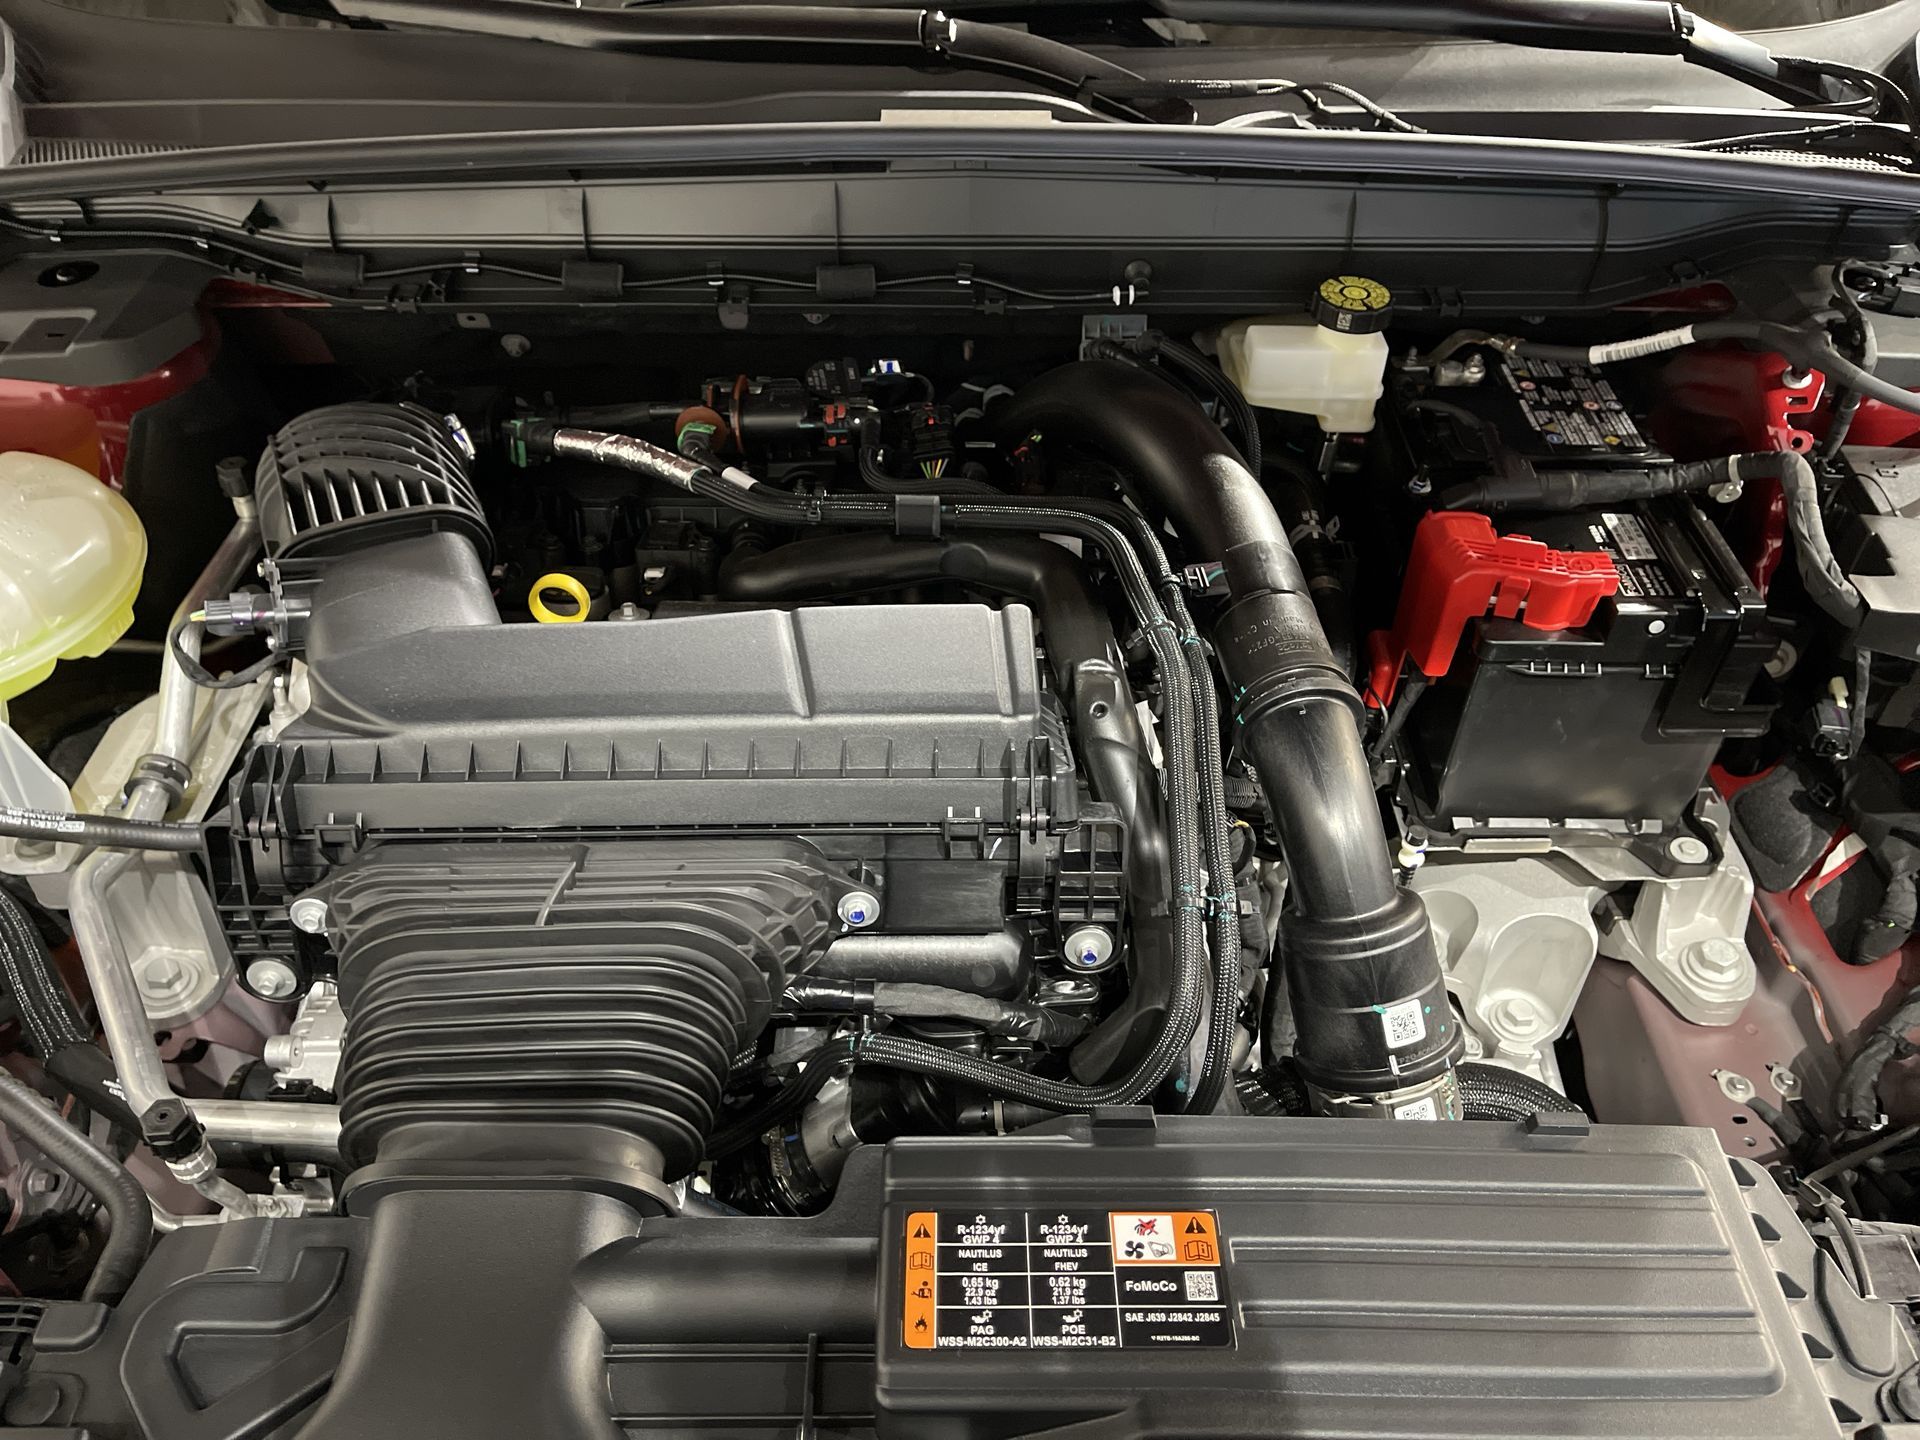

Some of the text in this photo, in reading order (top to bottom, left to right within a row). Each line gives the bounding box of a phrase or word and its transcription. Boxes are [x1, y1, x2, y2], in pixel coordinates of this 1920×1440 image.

[957, 1225, 1005, 1236] R-1234yf
[1040, 1225, 1088, 1236] R-1234yf
[962, 1235, 990, 1244] GWP
[1046, 1235, 1073, 1244] GWP
[958, 1249, 1002, 1258] NAUTILUS
[1043, 1249, 1088, 1258] NAUTILUS
[972, 1262, 988, 1272] ICE
[1054, 1262, 1078, 1271] FHEV
[962, 1277, 999, 1290] 0.65 kg
[1049, 1276, 1086, 1289] 0.62 kg
[1125, 1280, 1177, 1292] FoMoCo
[965, 1287, 996, 1297] 22.9 oz
[1052, 1287, 1084, 1296] 21.9 oz
[964, 1296, 998, 1305] 1.43 lbs
[1052, 1296, 1086, 1305] 1.37 lbs
[1125, 1312, 1220, 1322] SAE J639 J2842 J2845
[970, 1325, 994, 1335] PAG
[1061, 1324, 1086, 1335] POE
[938, 1336, 1027, 1347] WSS-M2C300-A2
[1033, 1336, 1116, 1346] WSS-M2C31-B2
